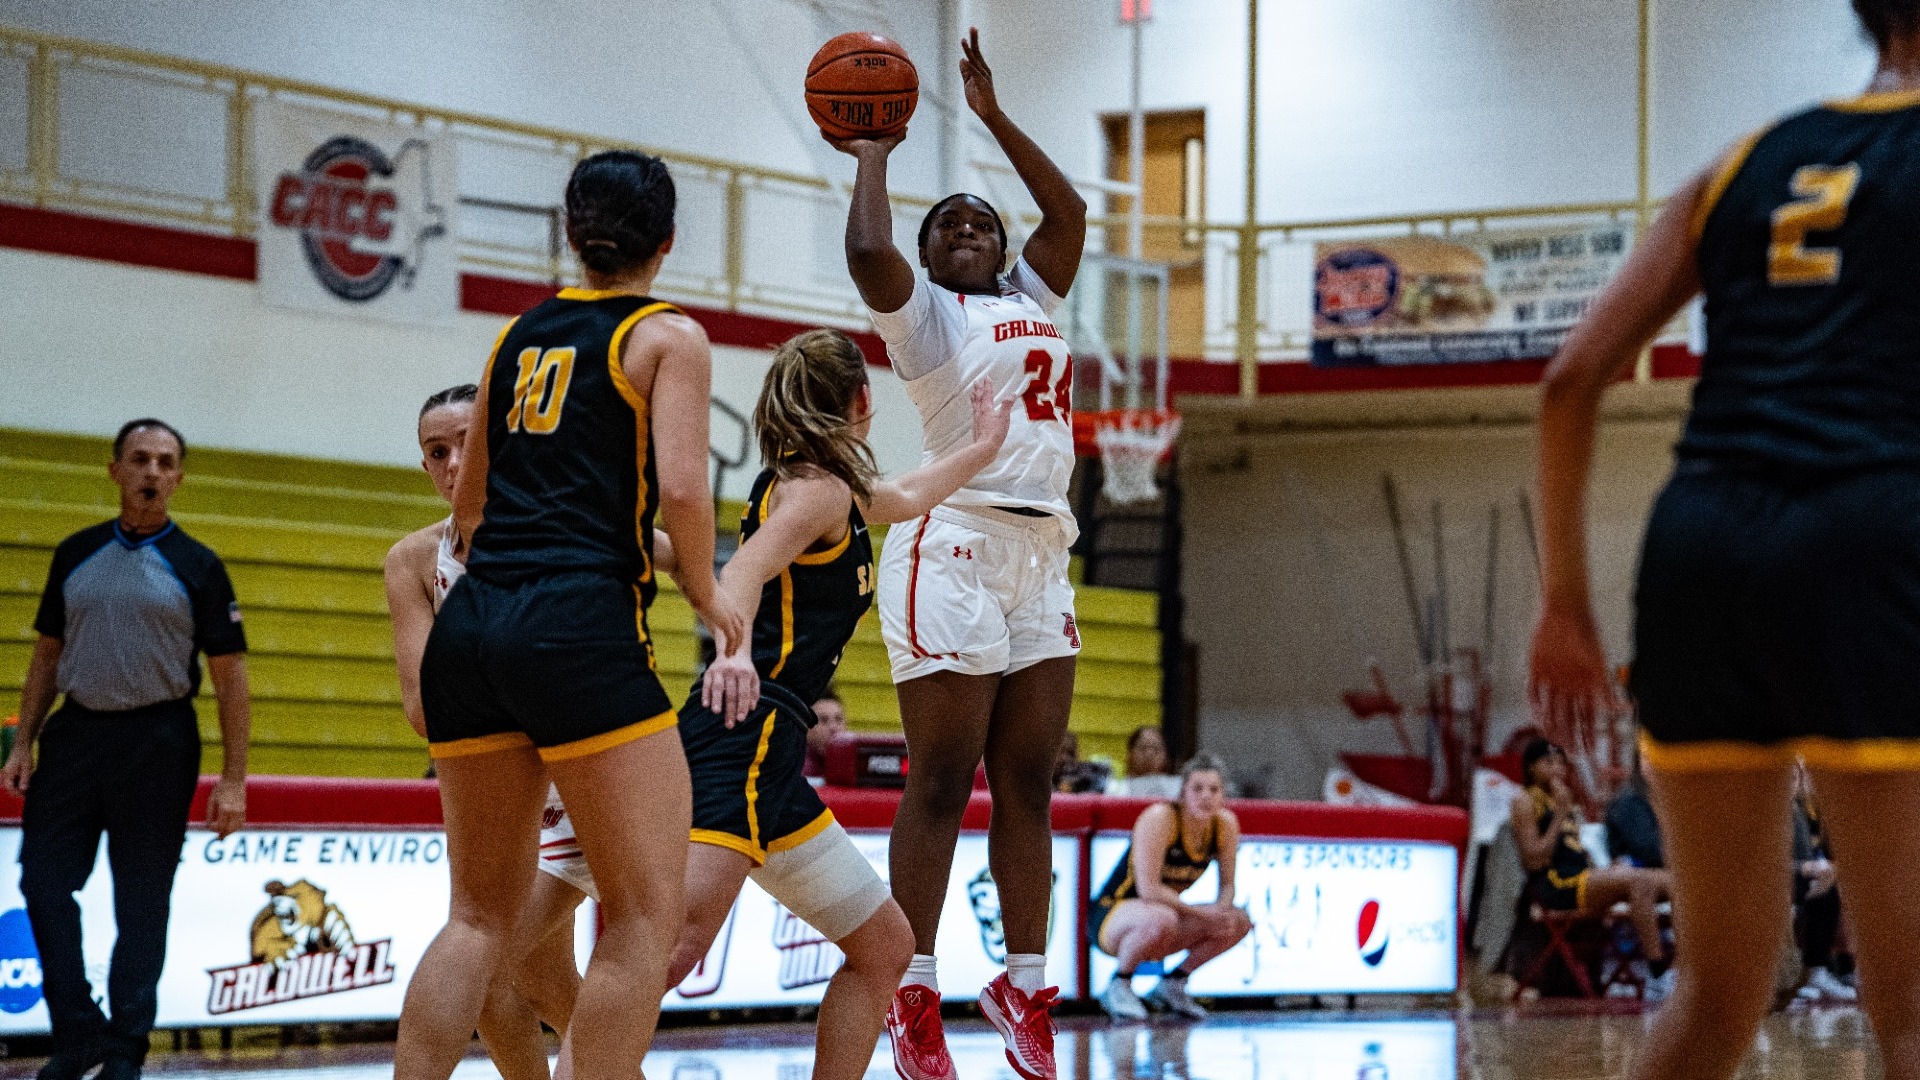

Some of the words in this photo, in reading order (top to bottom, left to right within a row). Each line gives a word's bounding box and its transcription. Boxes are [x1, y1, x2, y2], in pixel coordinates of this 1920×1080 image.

[854, 57, 887, 67] ROCK
[828, 100, 874, 127] ROCK
[270, 174, 397, 241] CACC
[1766, 161, 1861, 286] 2
[993, 320, 1064, 342] CALDW
[506, 346, 577, 434] 10
[1022, 348, 1073, 427] 24
[204, 836, 302, 863] GAME
[318, 836, 445, 863] ENVIRO
[1252, 845, 1294, 868] OUR
[1303, 845, 1412, 870] SPONSORS
